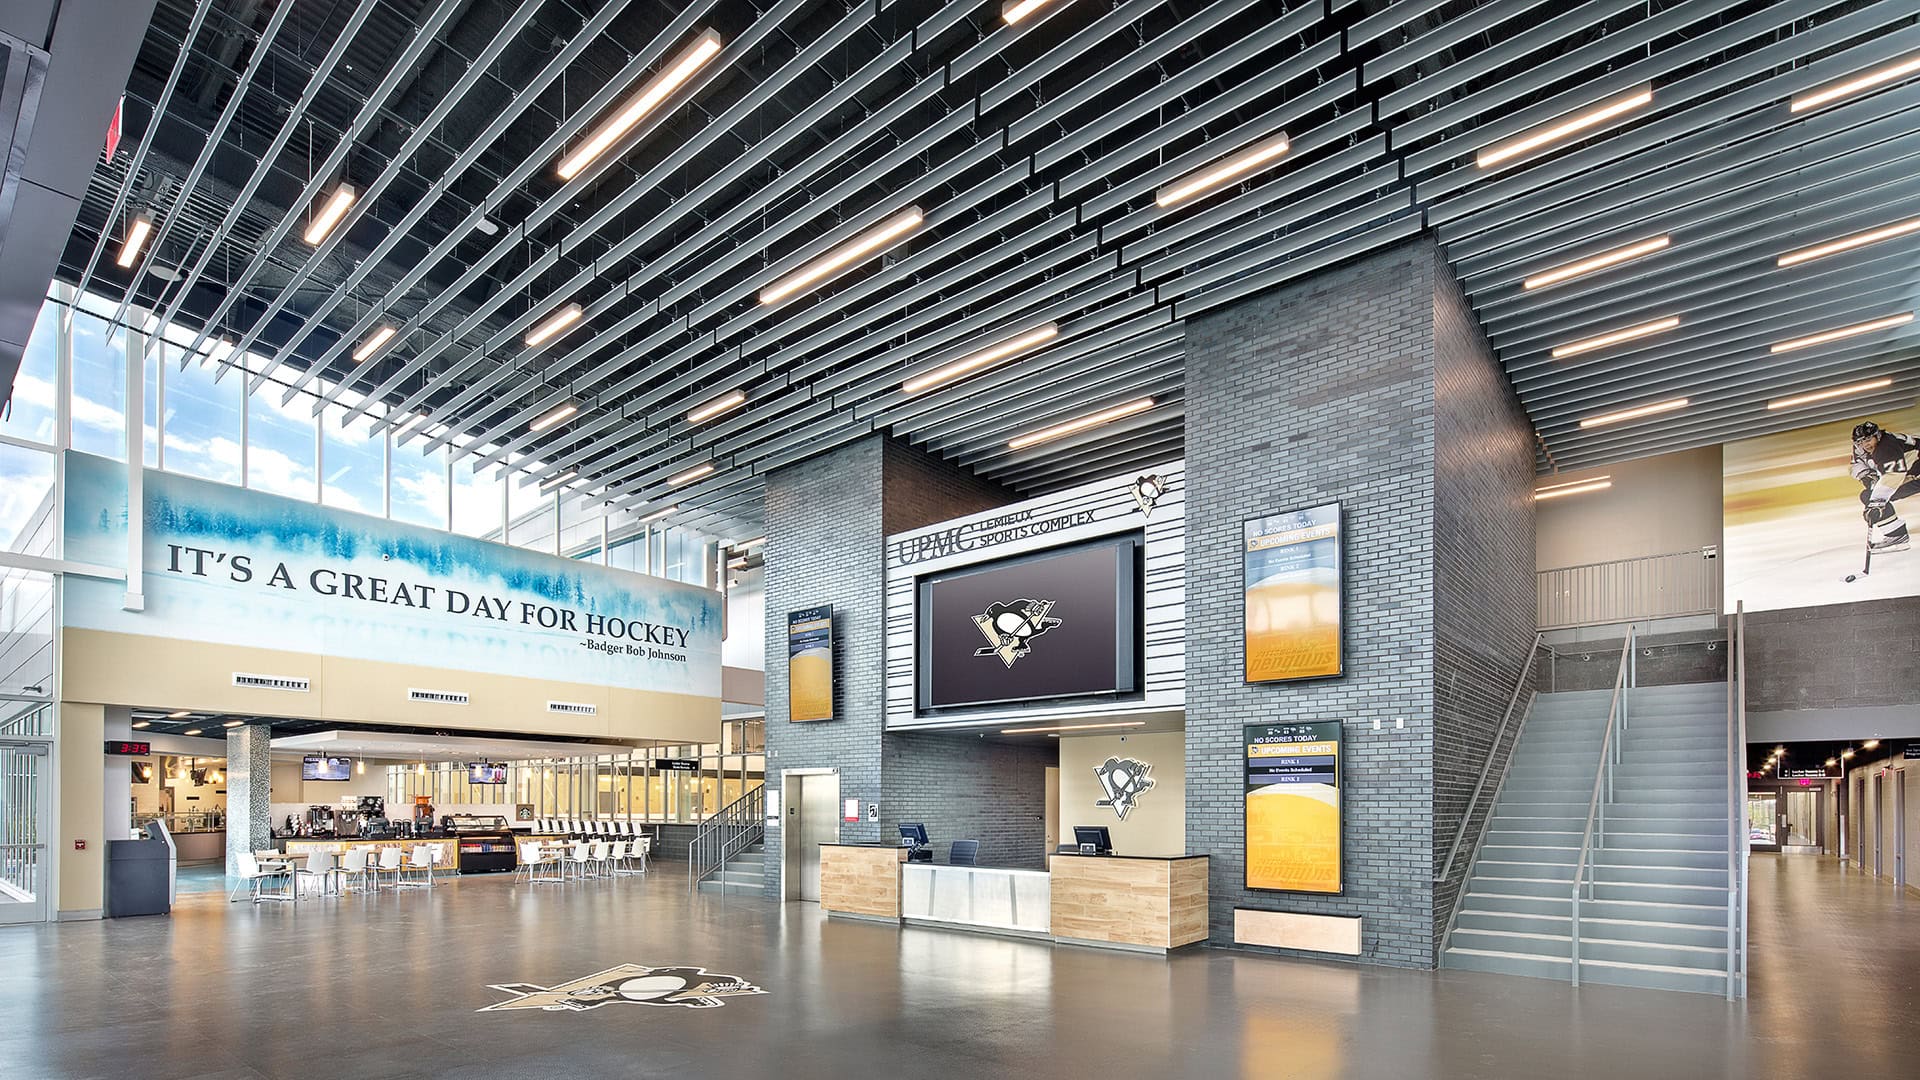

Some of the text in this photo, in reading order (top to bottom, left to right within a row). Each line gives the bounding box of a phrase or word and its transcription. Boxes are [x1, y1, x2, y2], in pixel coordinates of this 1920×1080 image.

[1883, 458, 1905, 473] 71
[980, 509, 1034, 531] LEMIEUX
[980, 509, 1096, 547] SPORTS COMPLEX
[1292, 519, 1317, 529] TODAY
[900, 524, 974, 565] UPMC
[167, 544, 691, 648] IT'S A GREAT DAY FOR HOCKEY
[626, 644, 646, 657] Bob
[647, 648, 687, 662] Johnson
[1265, 735, 1293, 743] SCORES
[1293, 734, 1318, 742] TODAY
[120, 743, 148, 753] 3:35
[1261, 744, 1332, 754] UPCOMING EVENTS
